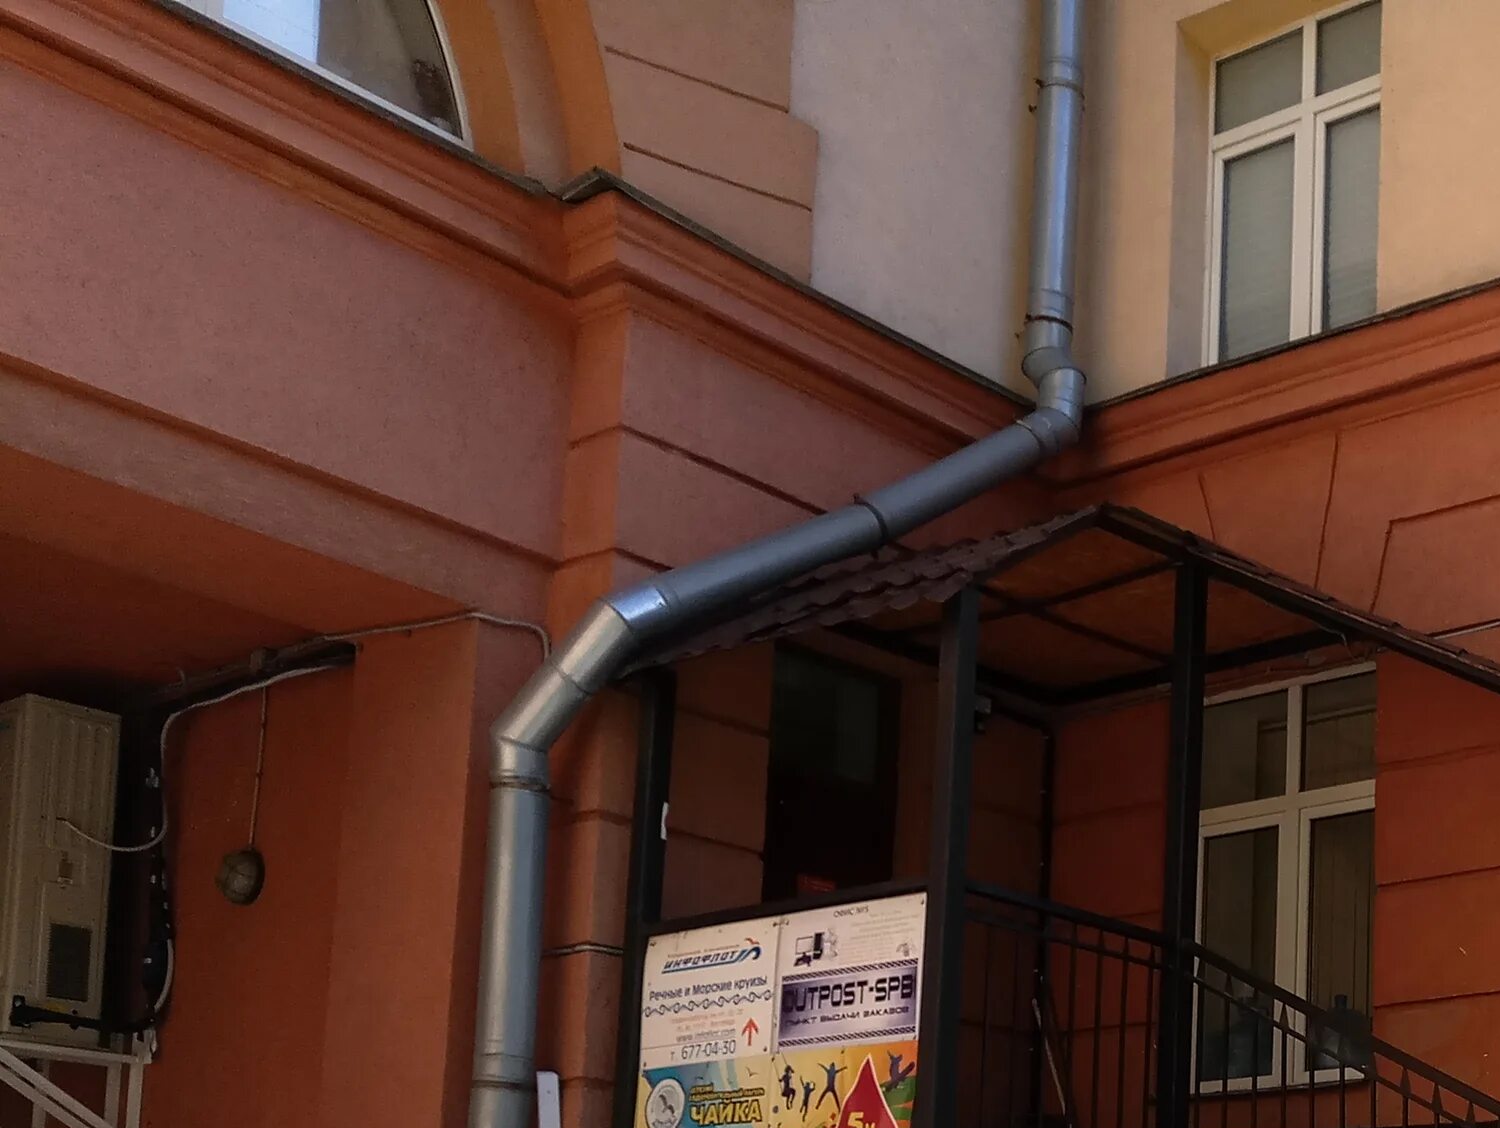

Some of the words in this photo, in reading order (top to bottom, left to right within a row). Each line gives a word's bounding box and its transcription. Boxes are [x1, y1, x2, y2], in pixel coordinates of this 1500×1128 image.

[650, 988, 684, 1001] Речные
[684, 988, 691, 996] и
[692, 980, 733, 997] Морские
[734, 976, 768, 991] круизы
[783, 974, 914, 1013] OUTPOST-SPB
[820, 1012, 860, 1023] ВЫДАЧИ
[863, 1006, 910, 1018] ЗАКАЗОВ
[681, 1040, 737, 1060] 677-04-30
[690, 1099, 763, 1126] ЧАЙКА
